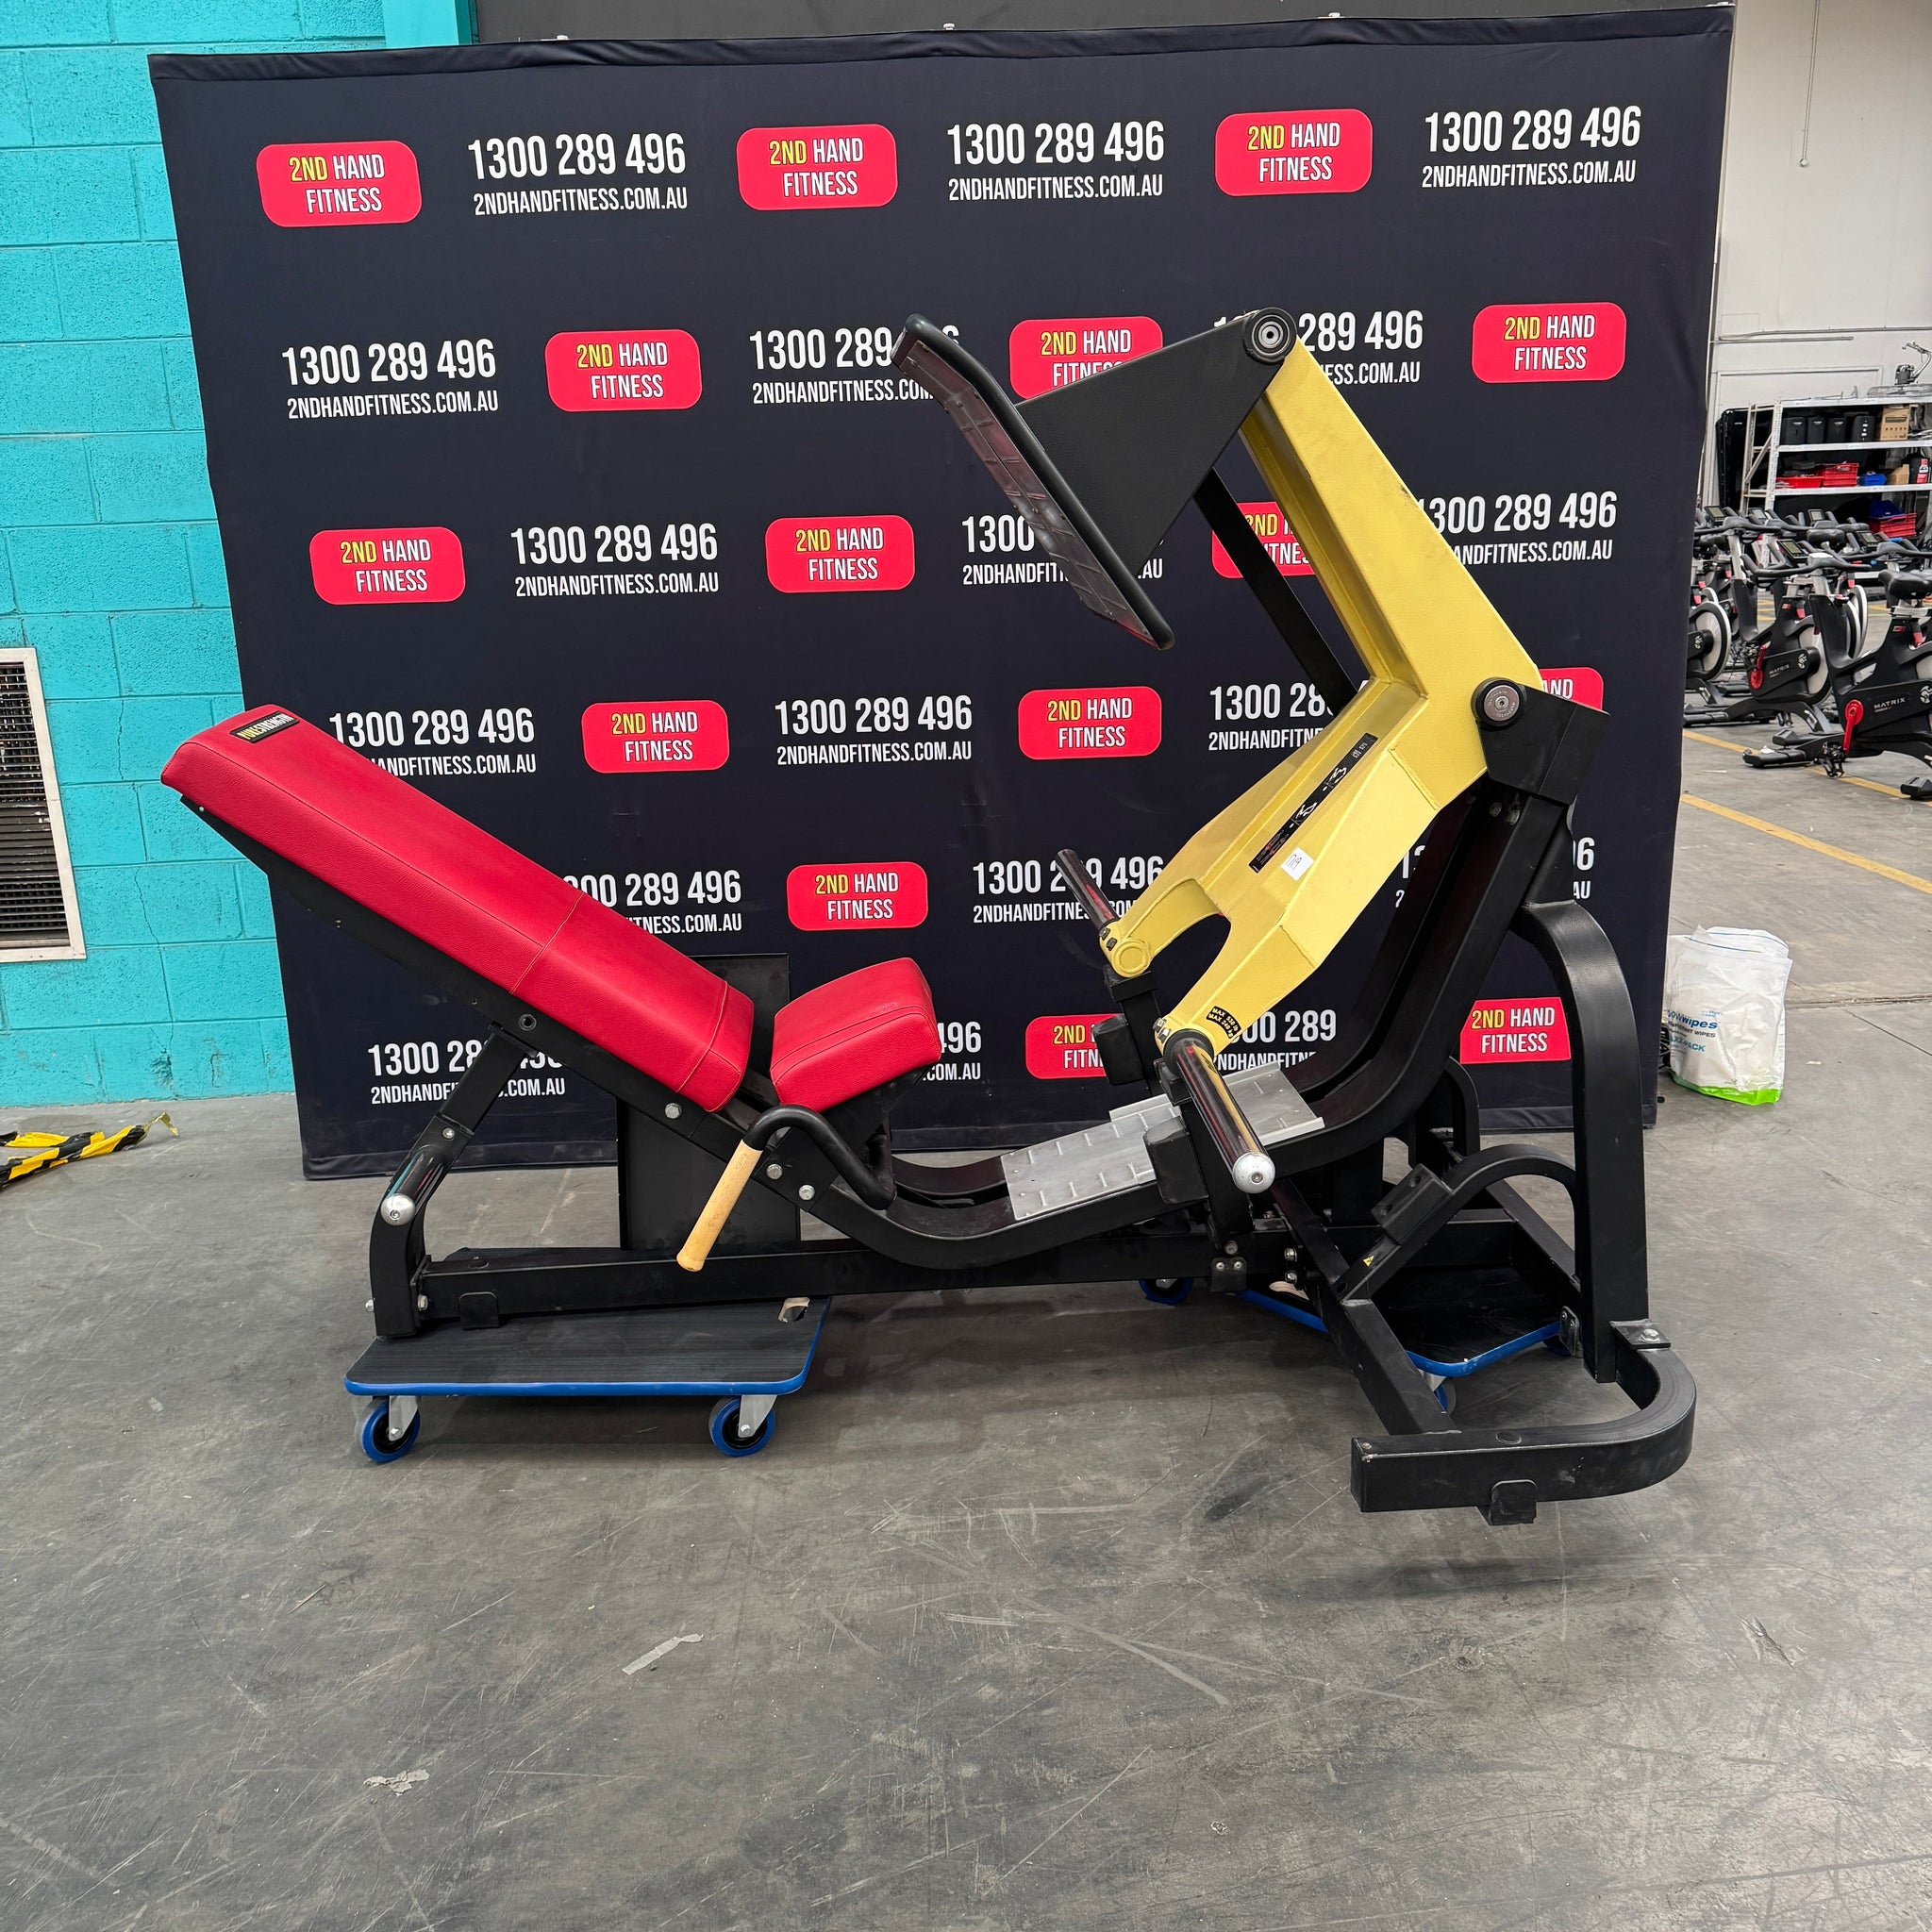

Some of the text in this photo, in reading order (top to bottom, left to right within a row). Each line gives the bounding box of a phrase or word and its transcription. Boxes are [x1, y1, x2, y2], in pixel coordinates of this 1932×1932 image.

[947, 120, 1164, 165] 1300 289 496
[1247, 122, 1341, 151] 2ND HAND
[1424, 105, 1641, 153] 1300 289 496
[467, 132, 686, 180] 1300 289 496
[769, 137, 863, 165] 2ND HAND
[289, 154, 385, 182] 2ND HAND
[1259, 155, 1333, 182] FITNESS
[1422, 159, 1637, 188] 2NDHANDFITNESS.COM.AU
[783, 170, 858, 197] FITNESS
[948, 174, 1163, 201] 2NDHANDFITNESS.COM.AU
[306, 186, 382, 213] FITNESS
[473, 186, 688, 216] 2NDHANDFITNESS.COM.AU
[1298, 309, 1424, 353] 289 496
[1504, 314, 1595, 341] 2ND HAND
[576, 341, 668, 368] 2ND HAND
[749, 328, 826, 370] 1300
[834, 326, 893, 368] 289
[1041, 329, 1131, 356] 2ND HAND
[281, 338, 496, 386] 1300 289 496
[1514, 345, 1587, 371] FITNESS
[591, 374, 664, 399] FITNESS
[287, 390, 499, 420] 2NDHANDFITNESS.COM.AU
[1411, 491, 1618, 534] 300 289 496
[340, 539, 431, 564] 2ND HAND
[510, 523, 718, 565] 1300 289 496
[795, 527, 884, 552] 2ND HAND
[355, 568, 428, 592] FITNESS
[808, 557, 878, 581] FITNESS
[514, 572, 719, 597] 2NDHANDFITNESS.COM.AU
[774, 694, 973, 735] 1300 289 496
[1047, 697, 1132, 722] 2ND HAND
[1209, 682, 1334, 721] 1300 28
[1874, 697, 1906, 709] MATRIX
[329, 707, 535, 748] 1300 289 496
[611, 711, 698, 735] 2ND HAND
[1058, 725, 1125, 748] FITNESS
[625, 739, 693, 762] FITNESS
[776, 741, 972, 766] 2NDHANDFITNESS.COM.AU
[563, 869, 741, 908] 00 289 496
[815, 872, 899, 894] 2ND HAND
[973, 859, 1041, 895] 1300
[827, 898, 893, 920] FITNESS
[1208, 1013, 1223, 1023] MAX
[1212, 1008, 1225, 1018] MAX
[1230, 1008, 1337, 1043] 00 289
[1471, 1007, 1556, 1029] 2ND HAND
[1053, 1024, 1086, 1044] 2ND
[1481, 1032, 1548, 1054] FITNESS
[367, 1041, 440, 1076] 1300
[447, 1039, 489, 1073] 28
[1064, 1048, 1105, 1069] FITN
